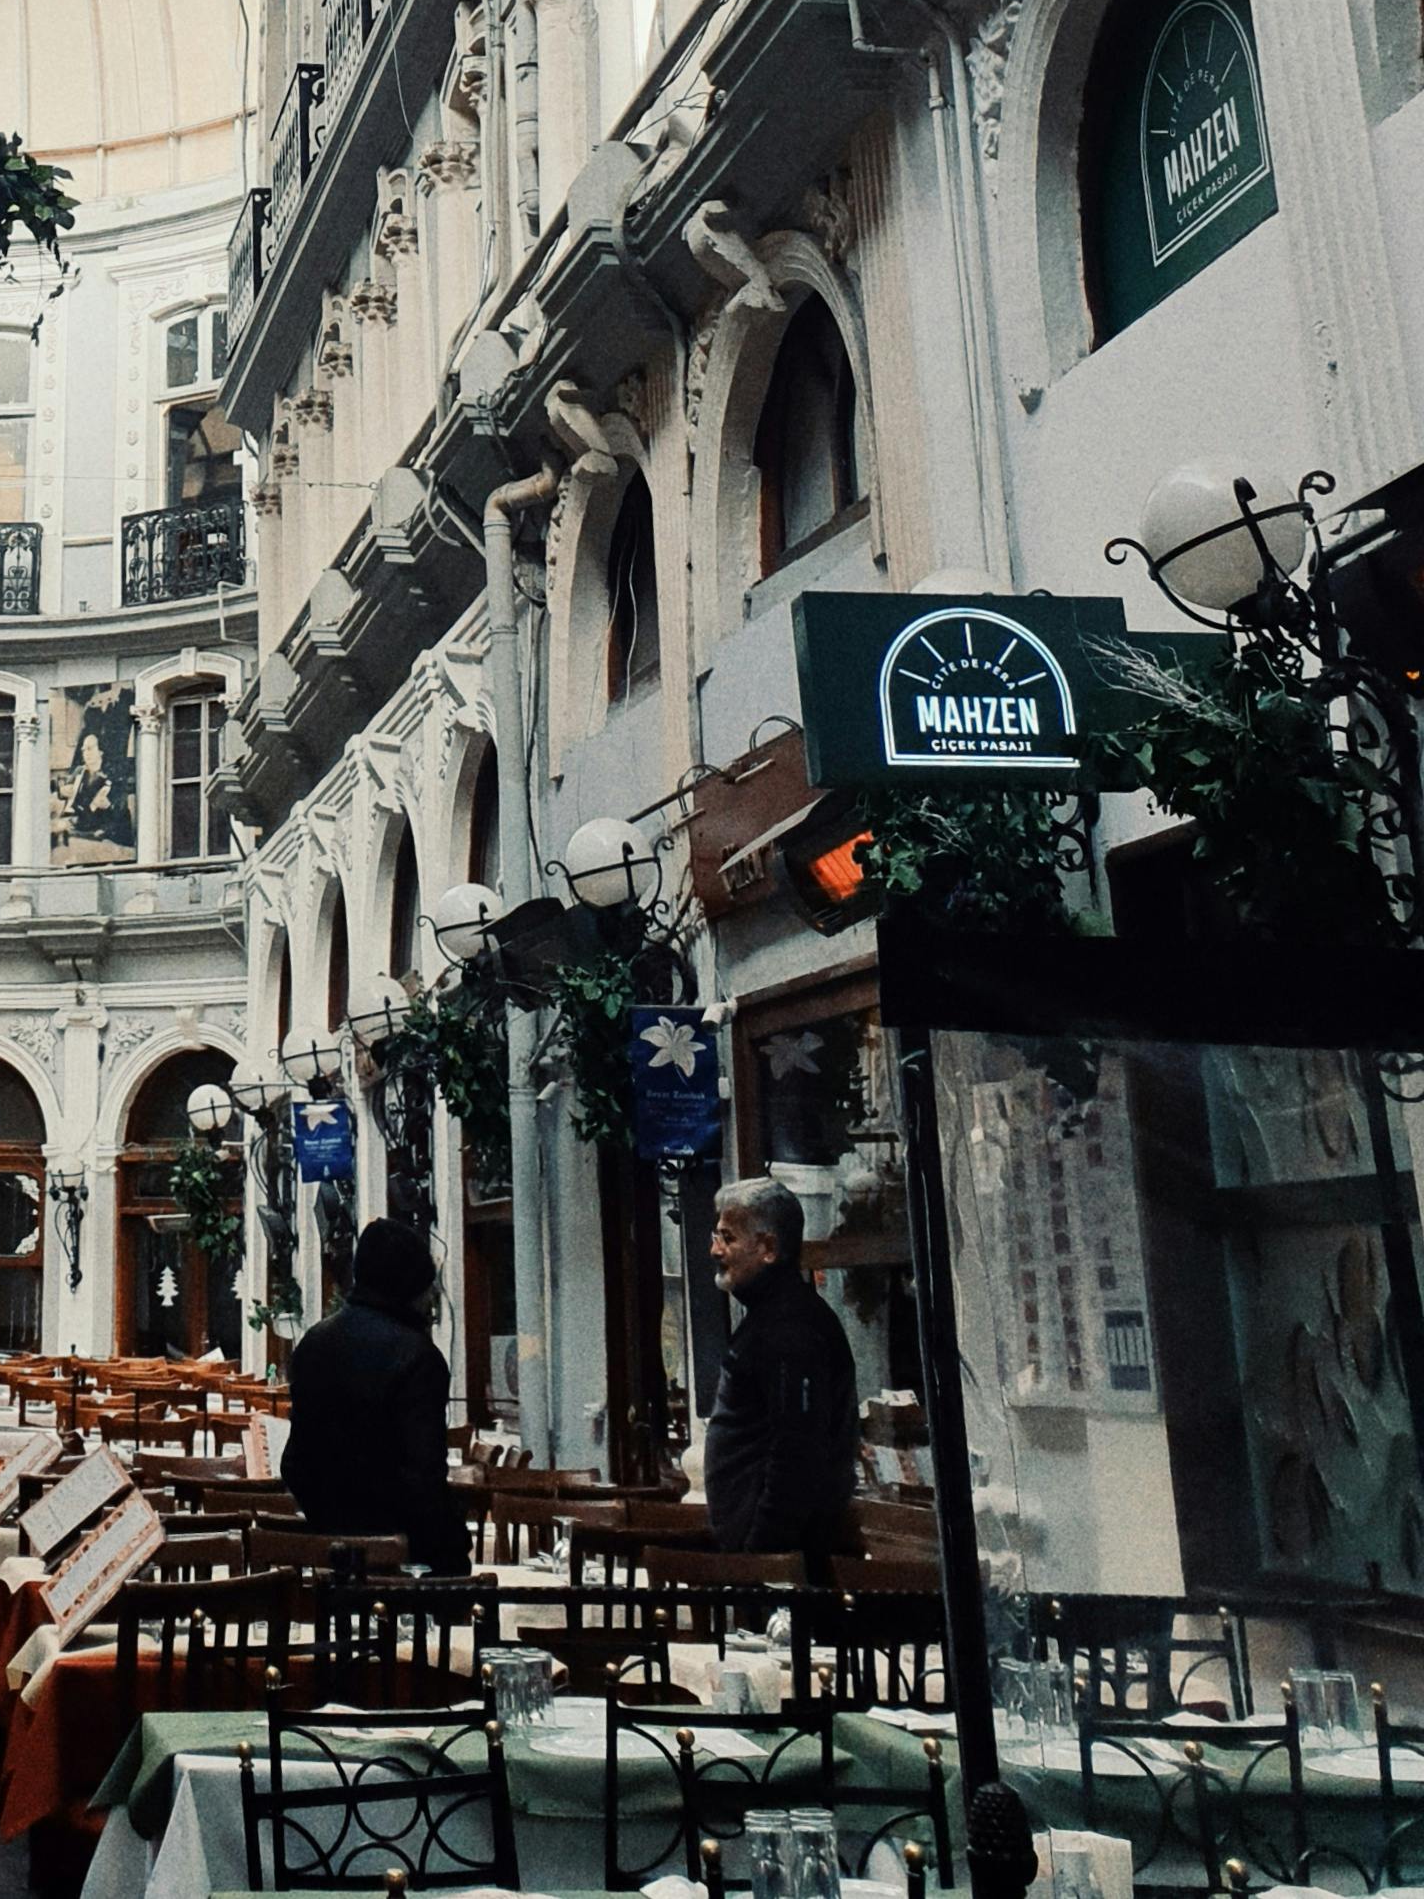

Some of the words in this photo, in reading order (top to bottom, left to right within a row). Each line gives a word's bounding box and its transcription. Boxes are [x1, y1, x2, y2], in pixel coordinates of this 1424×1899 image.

[1184, 72, 1196, 93] DE
[1164, 96, 1241, 206] MAHZEN
[1205, 163, 1239, 200] PASAJI
[961, 659, 979, 669] DE
[983, 661, 1016, 690] PERA
[916, 694, 1041, 736] MAHZEN
[930, 738, 977, 753] ÇİÇEK
[980, 740, 1033, 753] PASAJI
